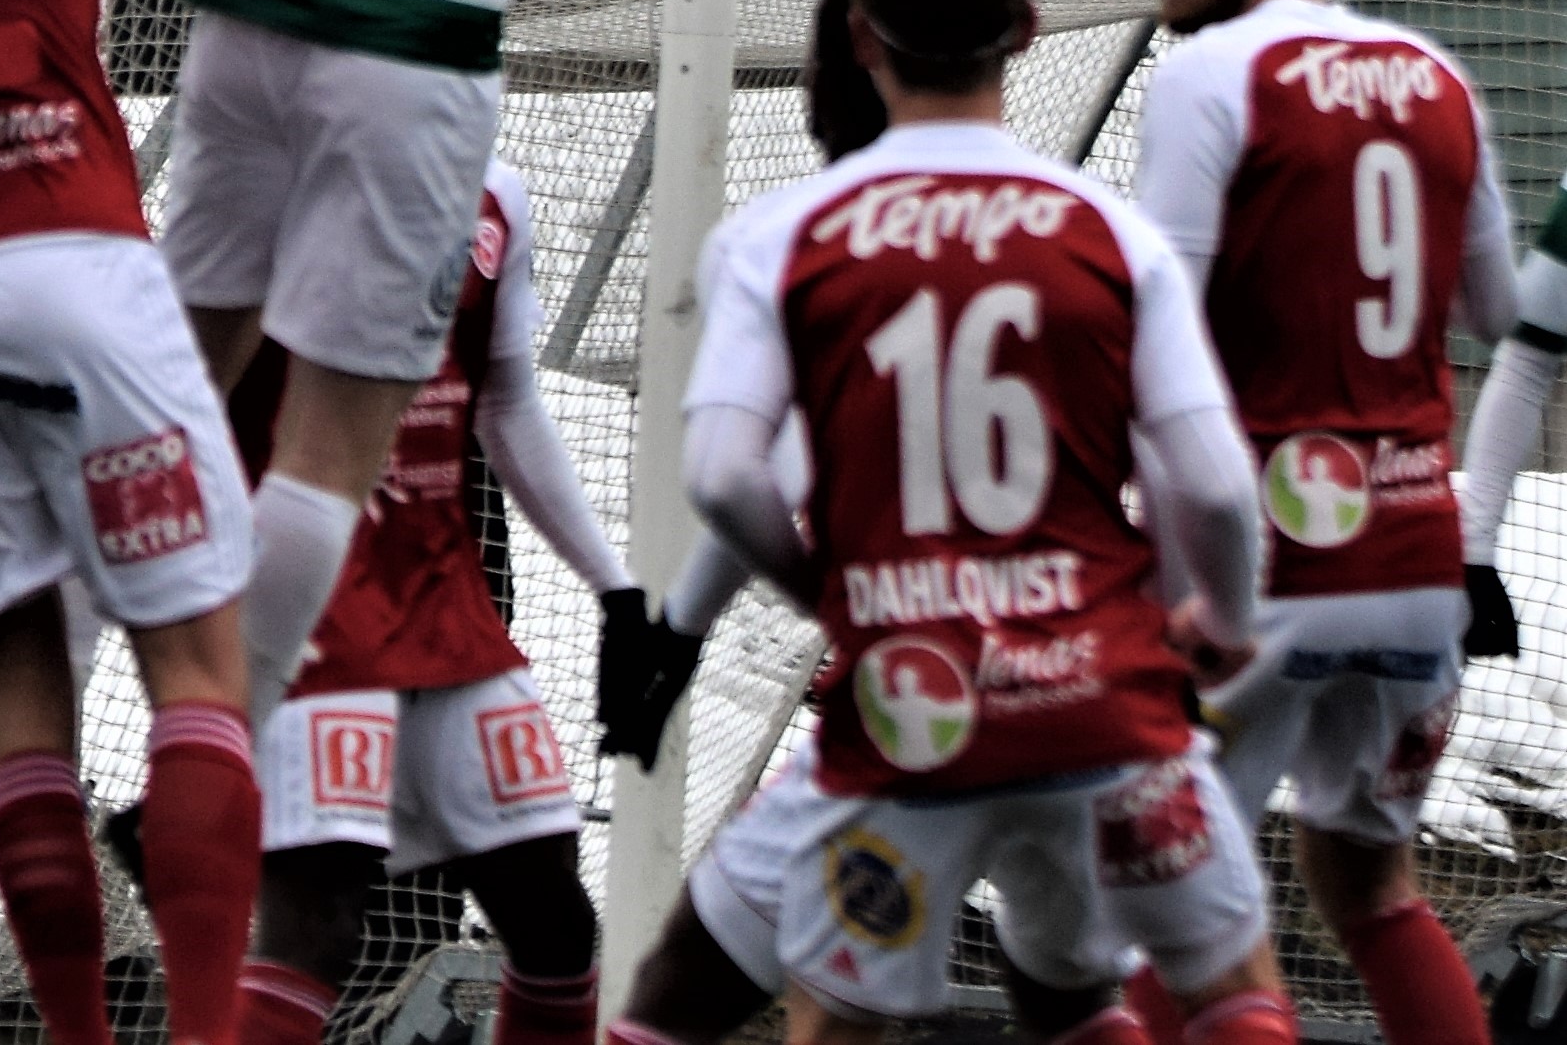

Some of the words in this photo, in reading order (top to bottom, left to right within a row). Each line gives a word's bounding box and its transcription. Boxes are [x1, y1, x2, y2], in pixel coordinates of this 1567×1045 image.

[1353, 139, 1423, 360] 9
[864, 280, 1054, 538] 16
[843, 552, 1086, 629] DAHLQVIST
